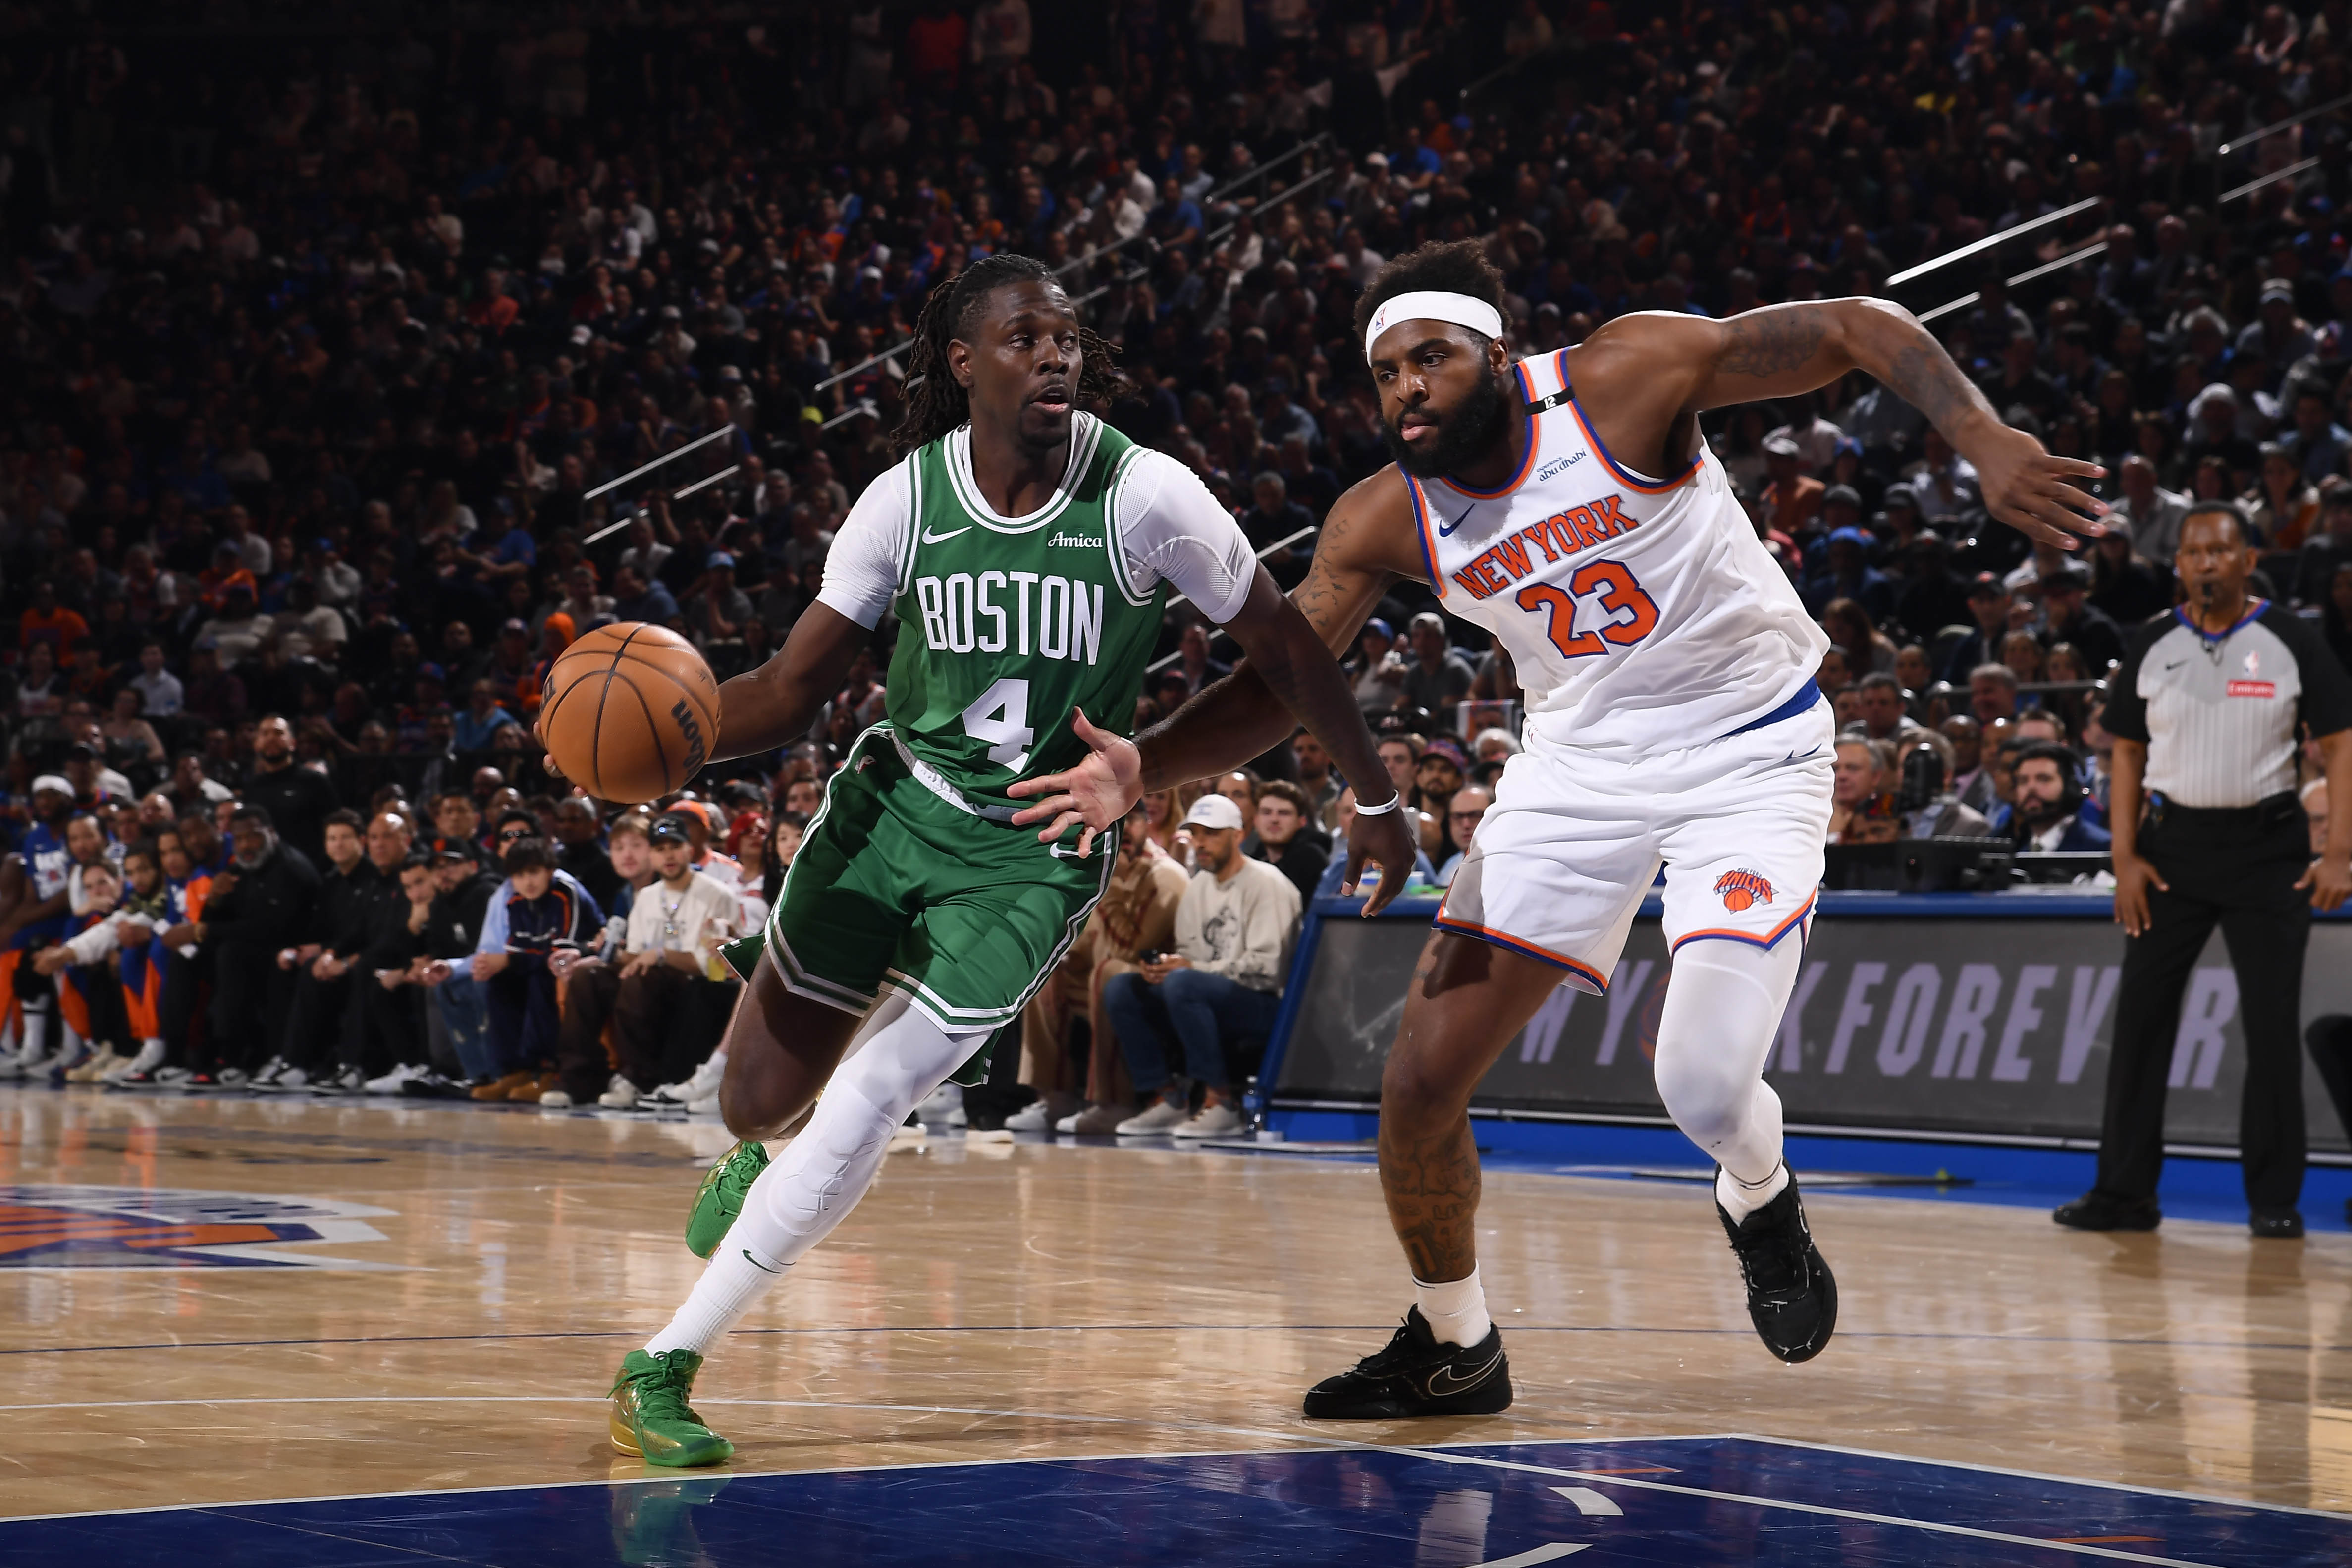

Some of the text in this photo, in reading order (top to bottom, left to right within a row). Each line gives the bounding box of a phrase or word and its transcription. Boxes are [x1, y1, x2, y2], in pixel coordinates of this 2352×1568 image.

[1544, 396, 1556, 409] 12
[1539, 448, 1587, 482] abu dhabi
[1048, 531, 1103, 548] Amica
[1451, 493, 1641, 600] NEW YORK
[915, 570, 1104, 665] BOSTON
[1515, 559, 1661, 659] 23
[962, 678, 1034, 775] 4
[1713, 869, 1773, 905] KNICKS
[1824, 962, 2240, 1089] FOREVR
